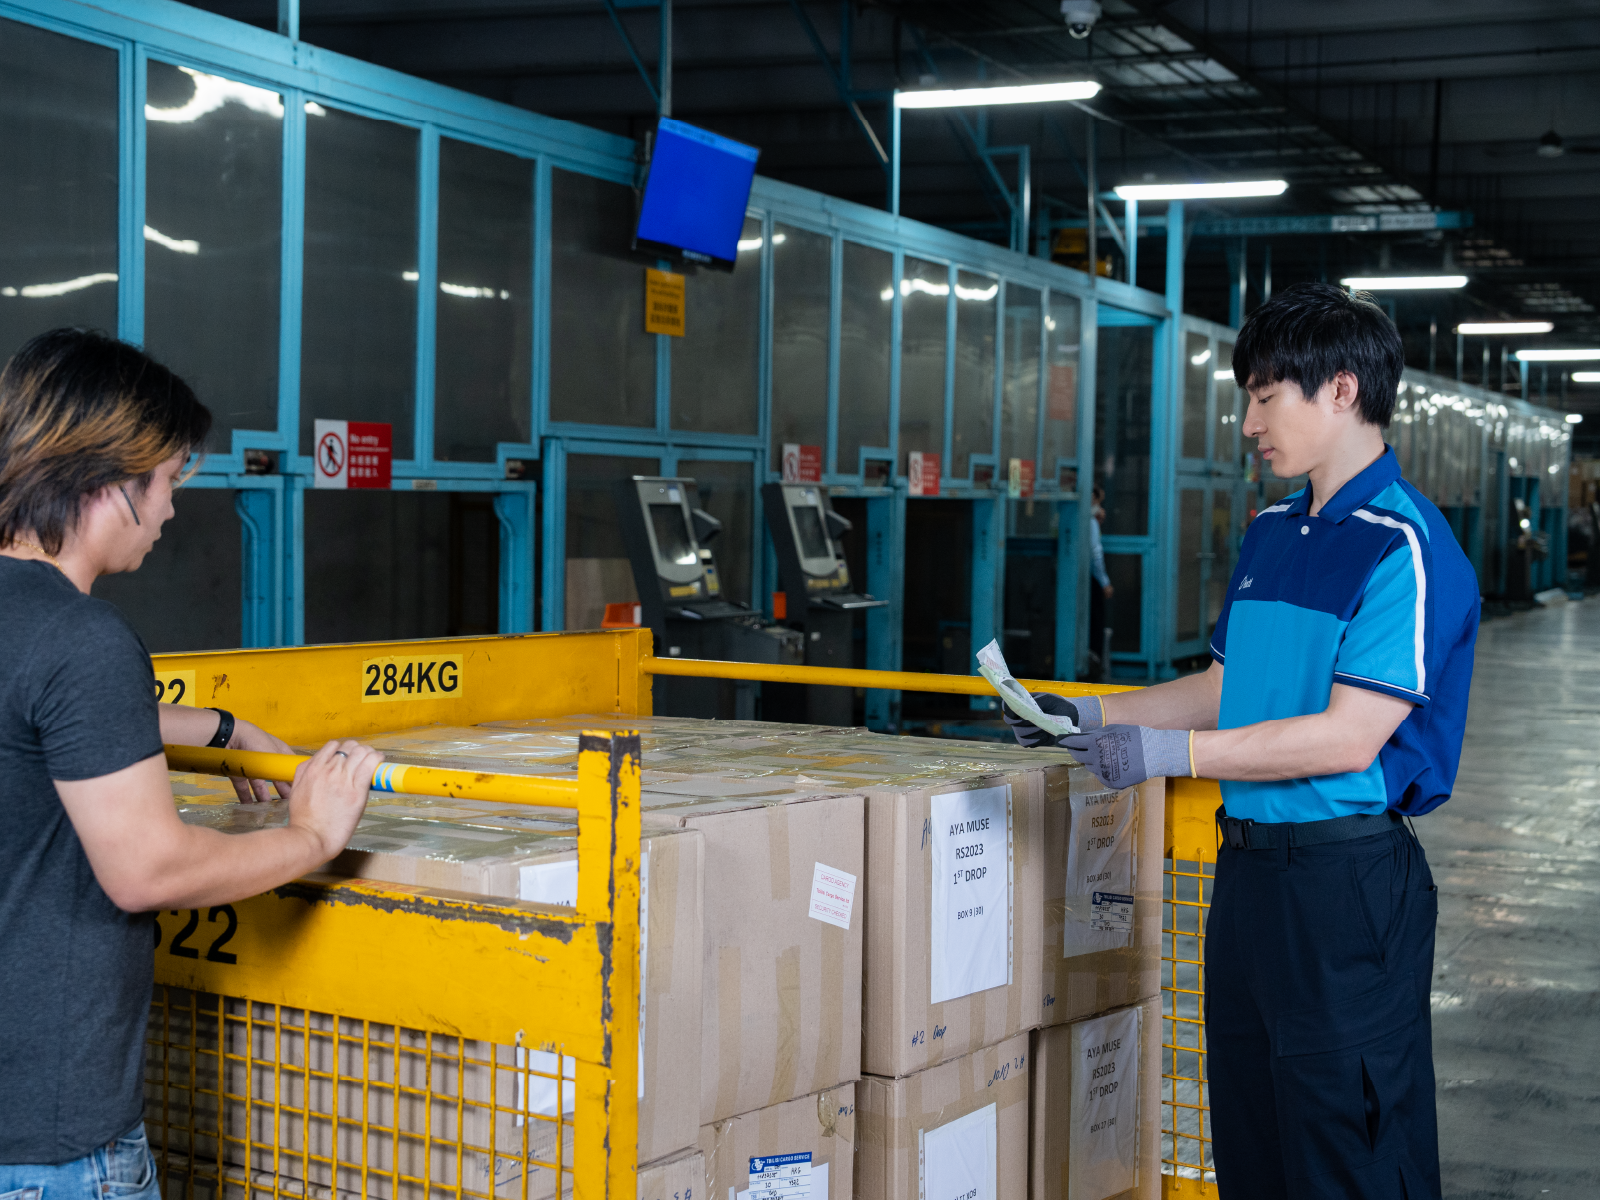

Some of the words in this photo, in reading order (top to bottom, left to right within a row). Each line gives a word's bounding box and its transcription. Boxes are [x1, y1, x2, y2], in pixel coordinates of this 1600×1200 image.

[364, 660, 459, 697] 284KG
[1085, 795, 1100, 807] AYA
[1100, 791, 1119, 805] MUSE
[949, 822, 965, 837] AYA
[966, 817, 990, 833] MUSE
[1091, 814, 1115, 829] RS2023
[955, 843, 984, 860] RS2023
[1087, 837, 1096, 851] 1ST
[1096, 835, 1115, 849] DROP
[820, 873, 835, 884] CARGO
[834, 879, 850, 889] AGENCY
[953, 869, 964, 885] 1ST
[965, 866, 987, 882] DROP
[957, 910, 969, 920] BOX
[154, 904, 238, 965] 22
[1086, 1045, 1100, 1060] AYA
[1101, 1038, 1121, 1055] MUSE
[1092, 1061, 1116, 1080] RS2023
[1099, 1081, 1119, 1098] DROP
[1090, 1123, 1101, 1133] BOX
